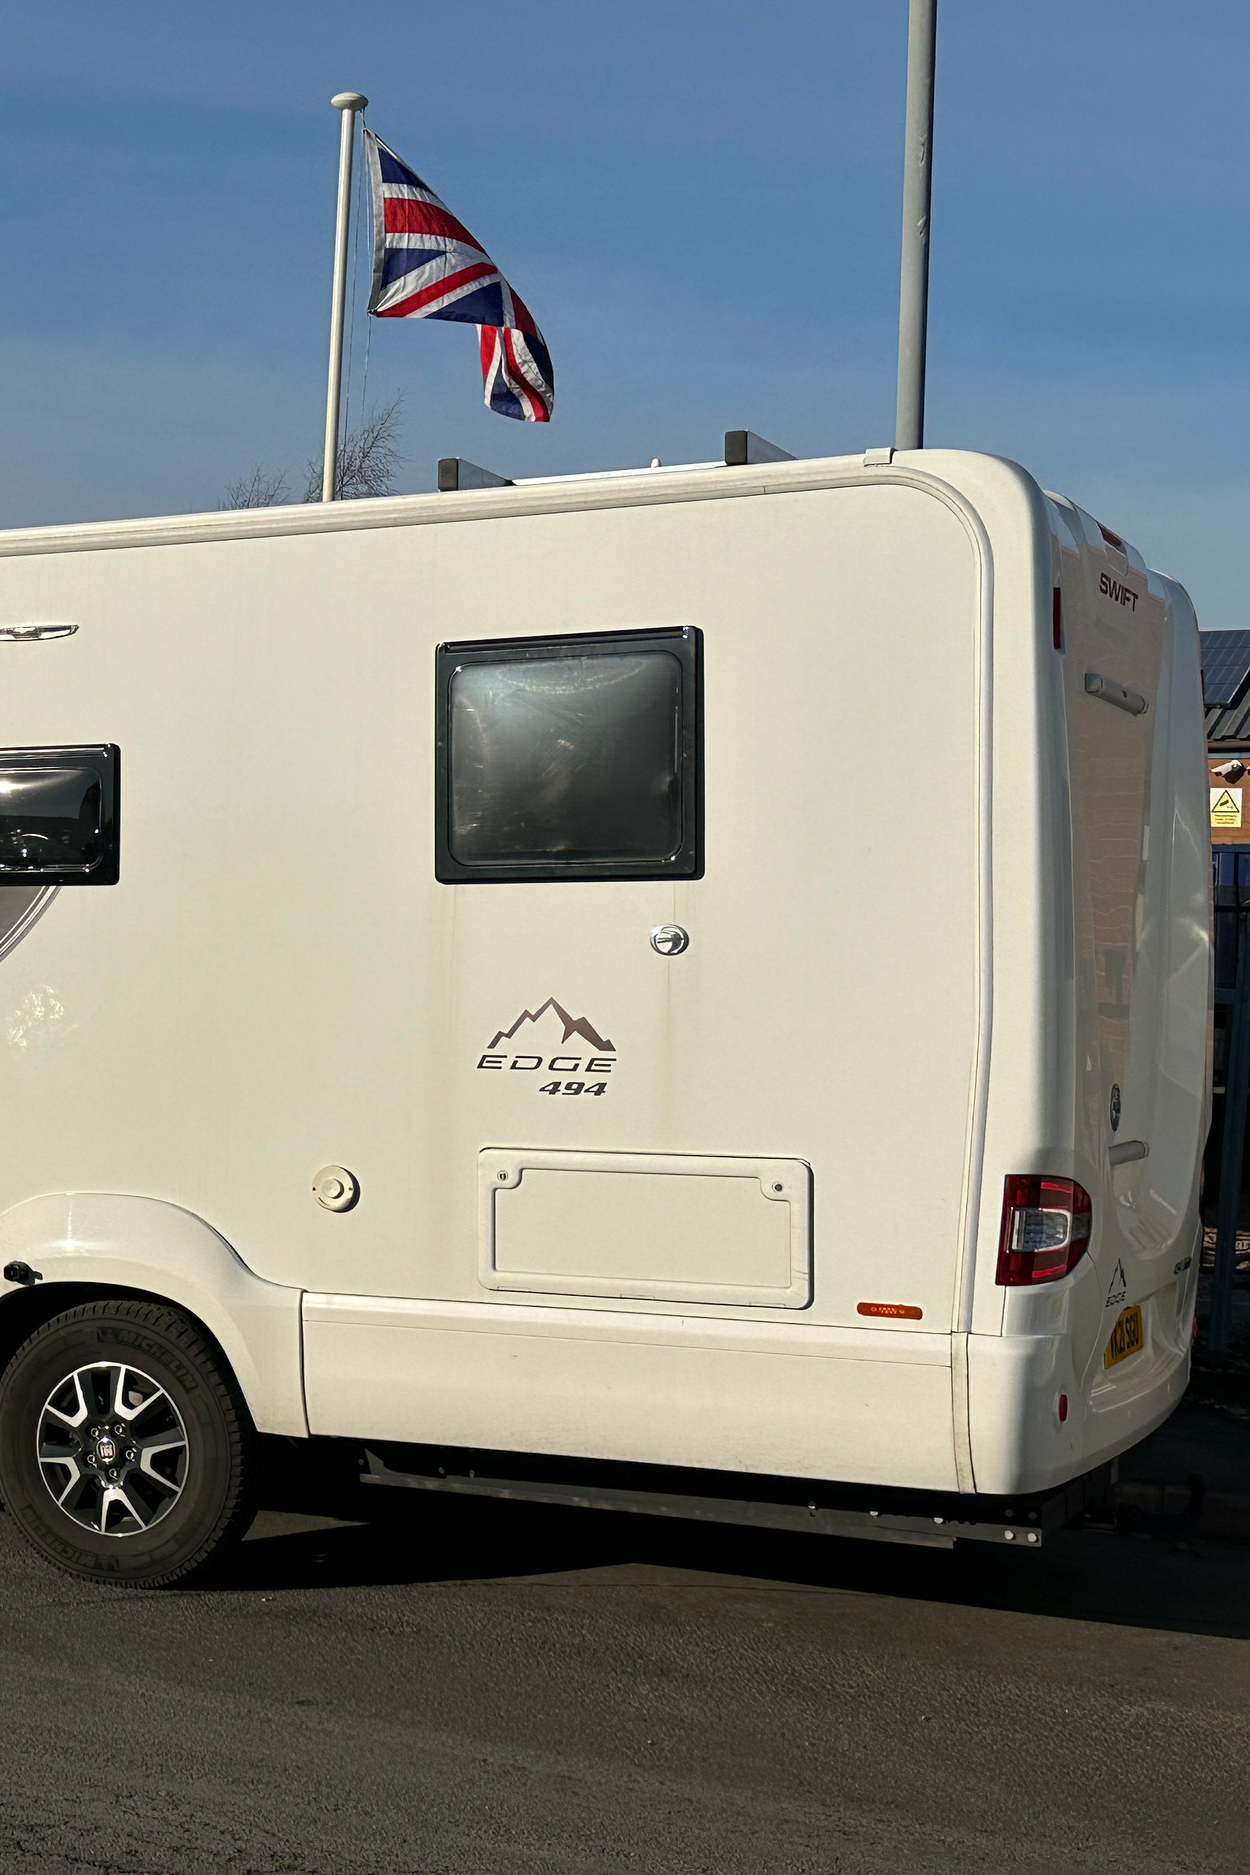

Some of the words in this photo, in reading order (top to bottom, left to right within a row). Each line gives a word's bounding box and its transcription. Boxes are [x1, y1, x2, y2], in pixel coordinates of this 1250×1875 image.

[1099, 572, 1139, 612] SWIFT
[477, 1054, 617, 1073] EDGE
[538, 1081, 608, 1096] 494
[1105, 1291, 1126, 1307] EDGE
